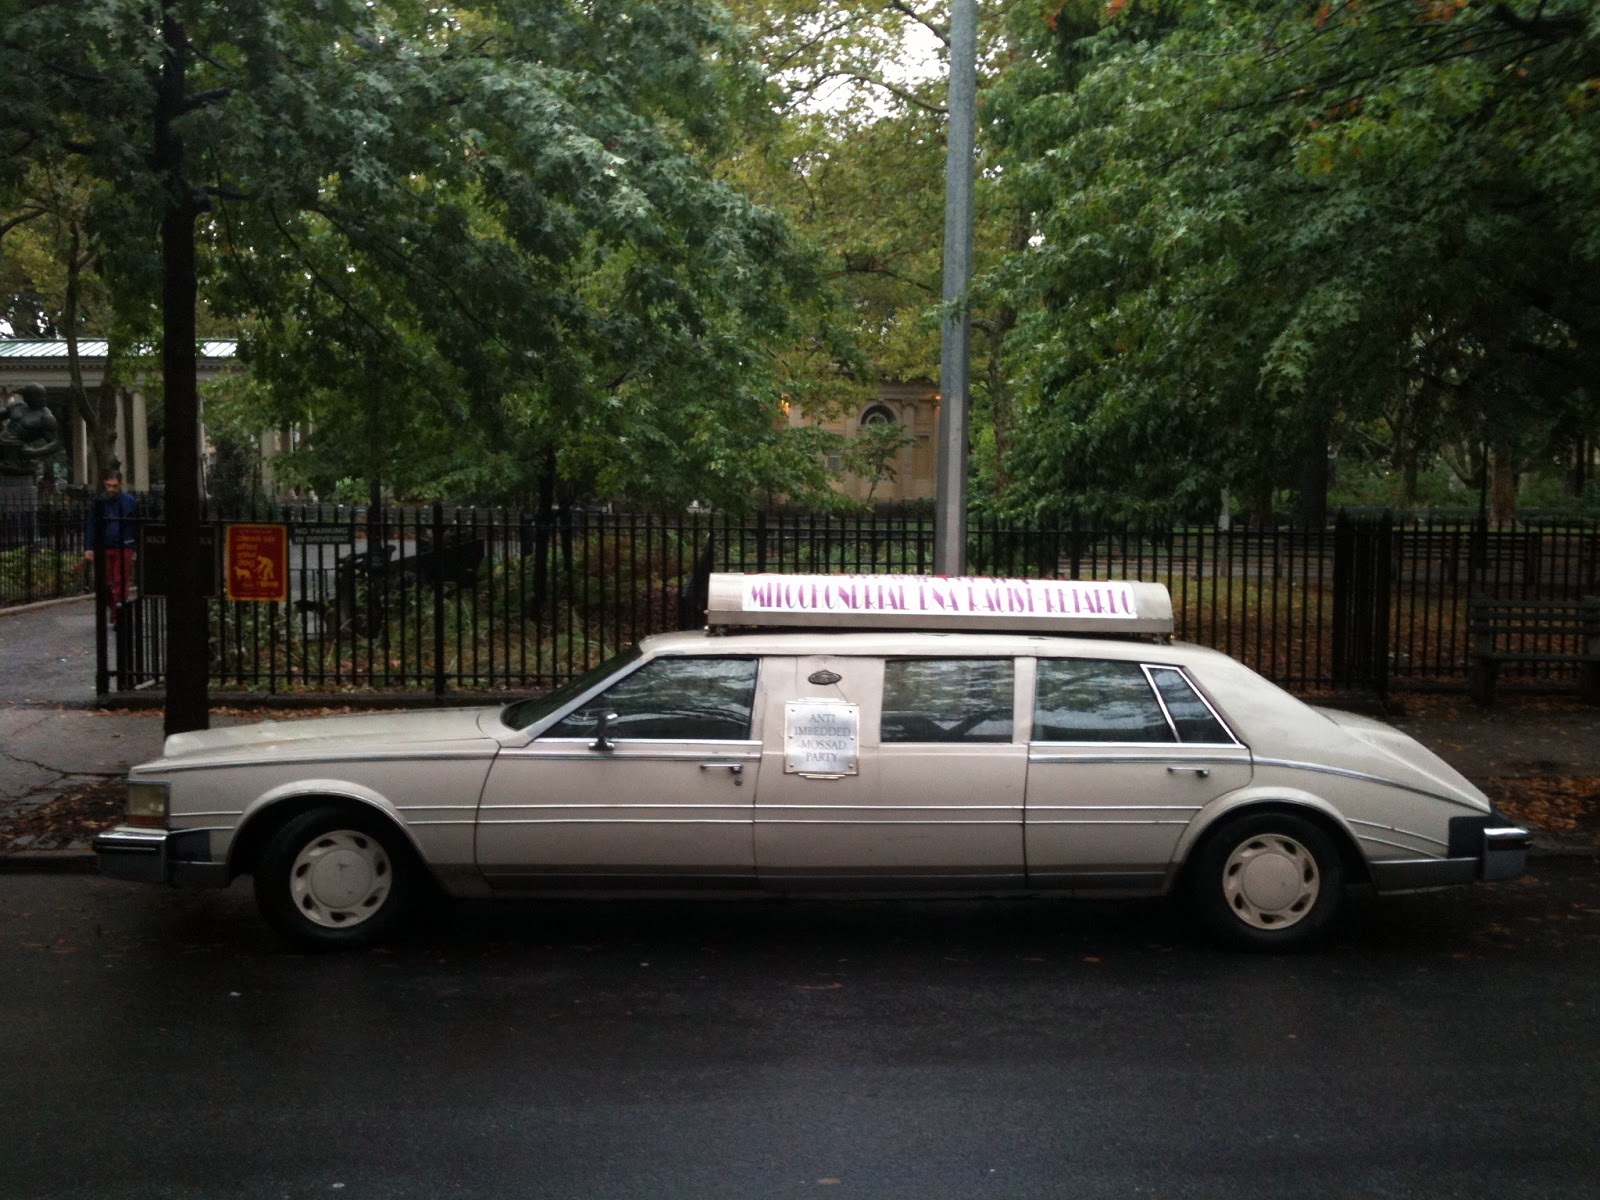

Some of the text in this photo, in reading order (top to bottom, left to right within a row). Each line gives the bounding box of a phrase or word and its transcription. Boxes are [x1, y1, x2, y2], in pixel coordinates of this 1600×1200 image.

[294, 527, 308, 535] NO
[919, 585, 960, 613] DNA
[808, 713, 836, 724] ANTI
[794, 726, 852, 737] IMBEDDED
[799, 739, 847, 750] MOSSAD
[806, 752, 839, 762] PARTY
